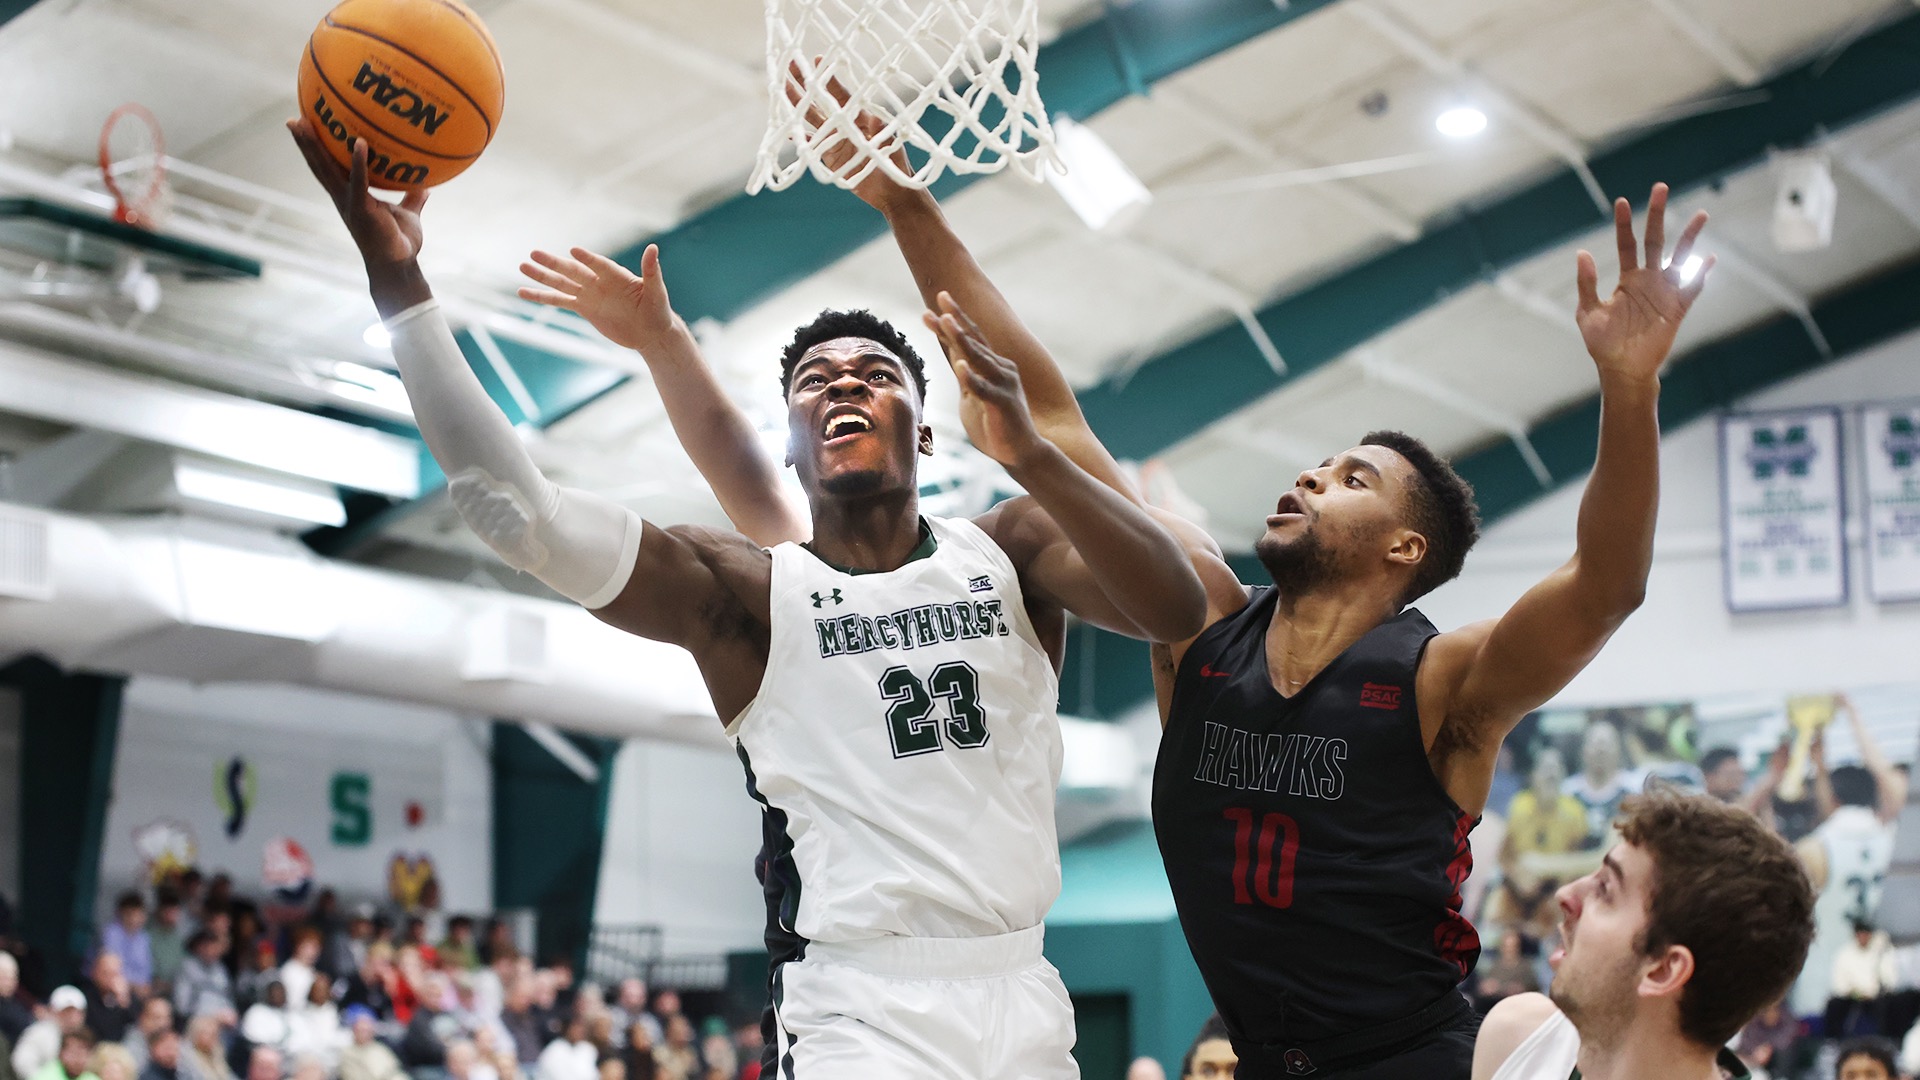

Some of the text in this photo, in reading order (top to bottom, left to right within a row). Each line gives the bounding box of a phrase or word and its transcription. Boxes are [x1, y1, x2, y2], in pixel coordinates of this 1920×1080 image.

[352, 61, 449, 136] NCAA
[815, 599, 1009, 658] MERCYHURST
[878, 660, 990, 759] 23
[1361, 690, 1402, 704] PSAC
[1194, 721, 1348, 801] HAWKS
[330, 769, 373, 846] S
[1223, 807, 1300, 910] 10
